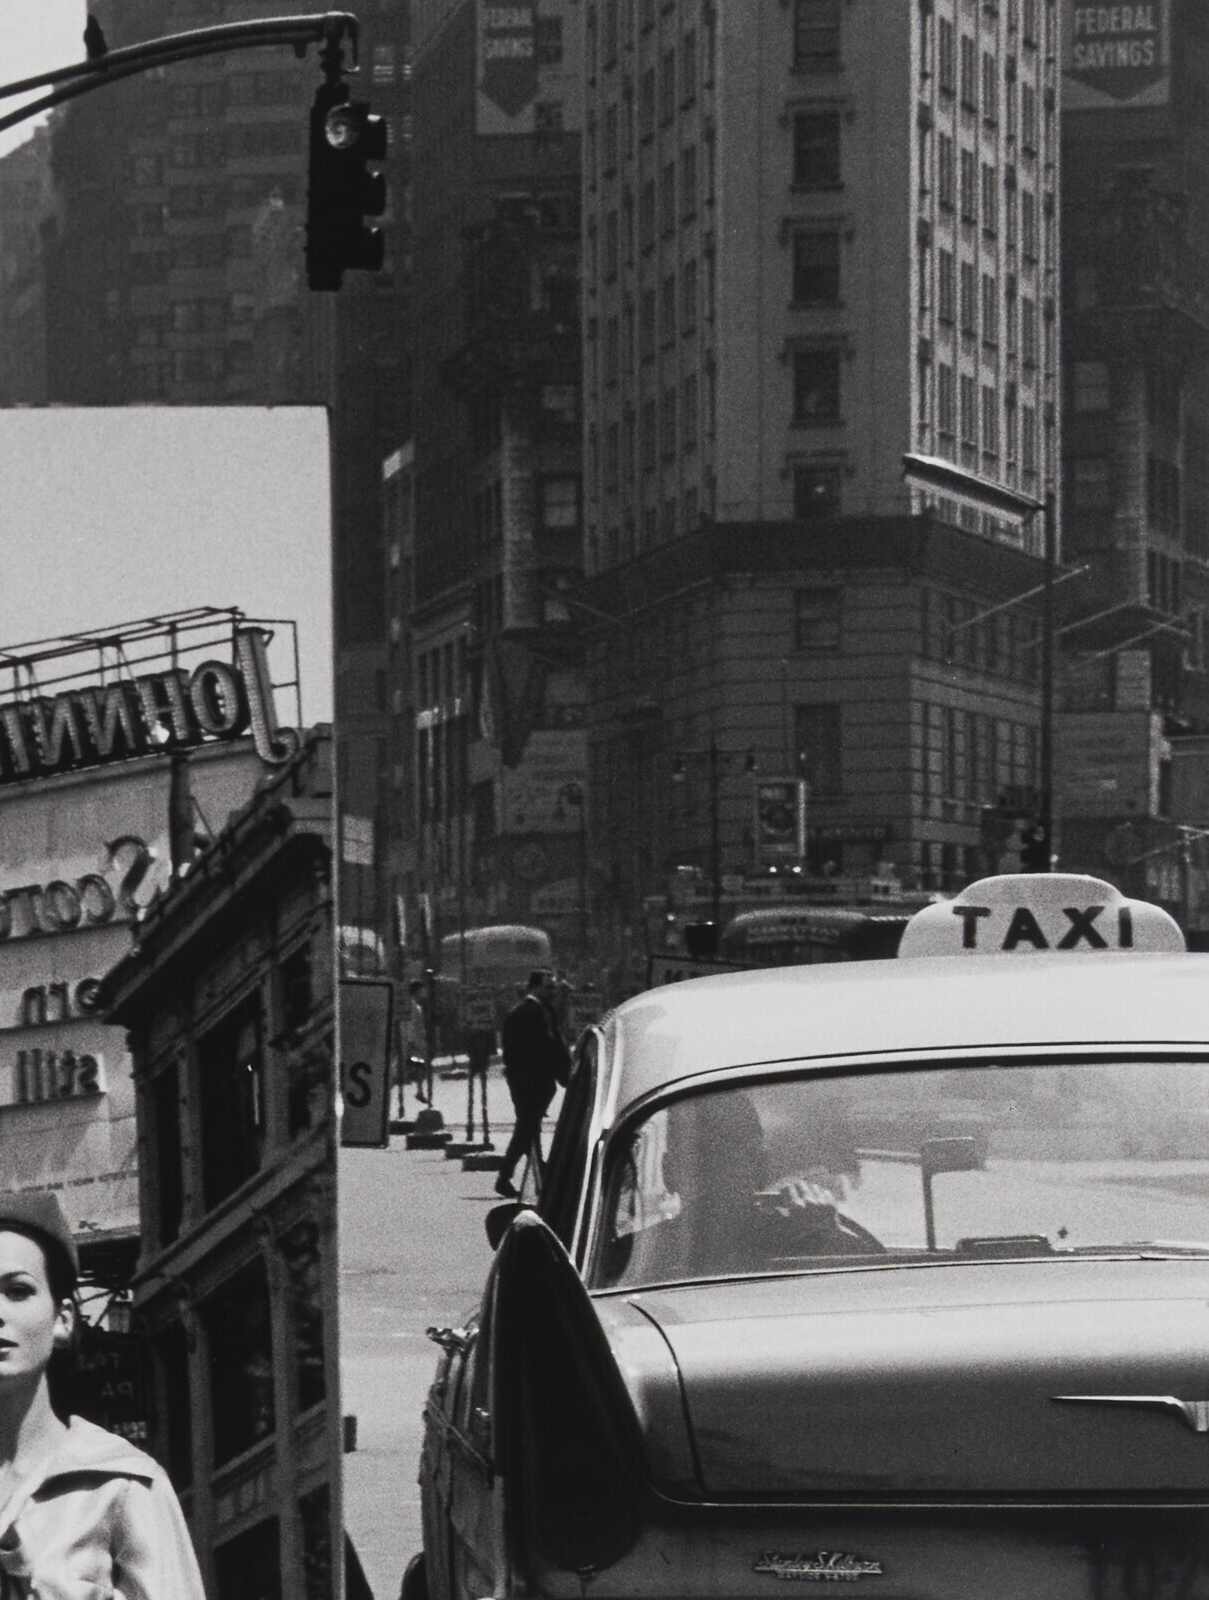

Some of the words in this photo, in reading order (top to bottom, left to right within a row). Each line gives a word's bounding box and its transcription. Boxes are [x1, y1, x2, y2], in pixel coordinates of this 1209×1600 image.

[1073, 5, 1158, 34] FEDERAL
[1073, 39, 1156, 69] SAVINGS
[952, 905, 1134, 951] TAXI
